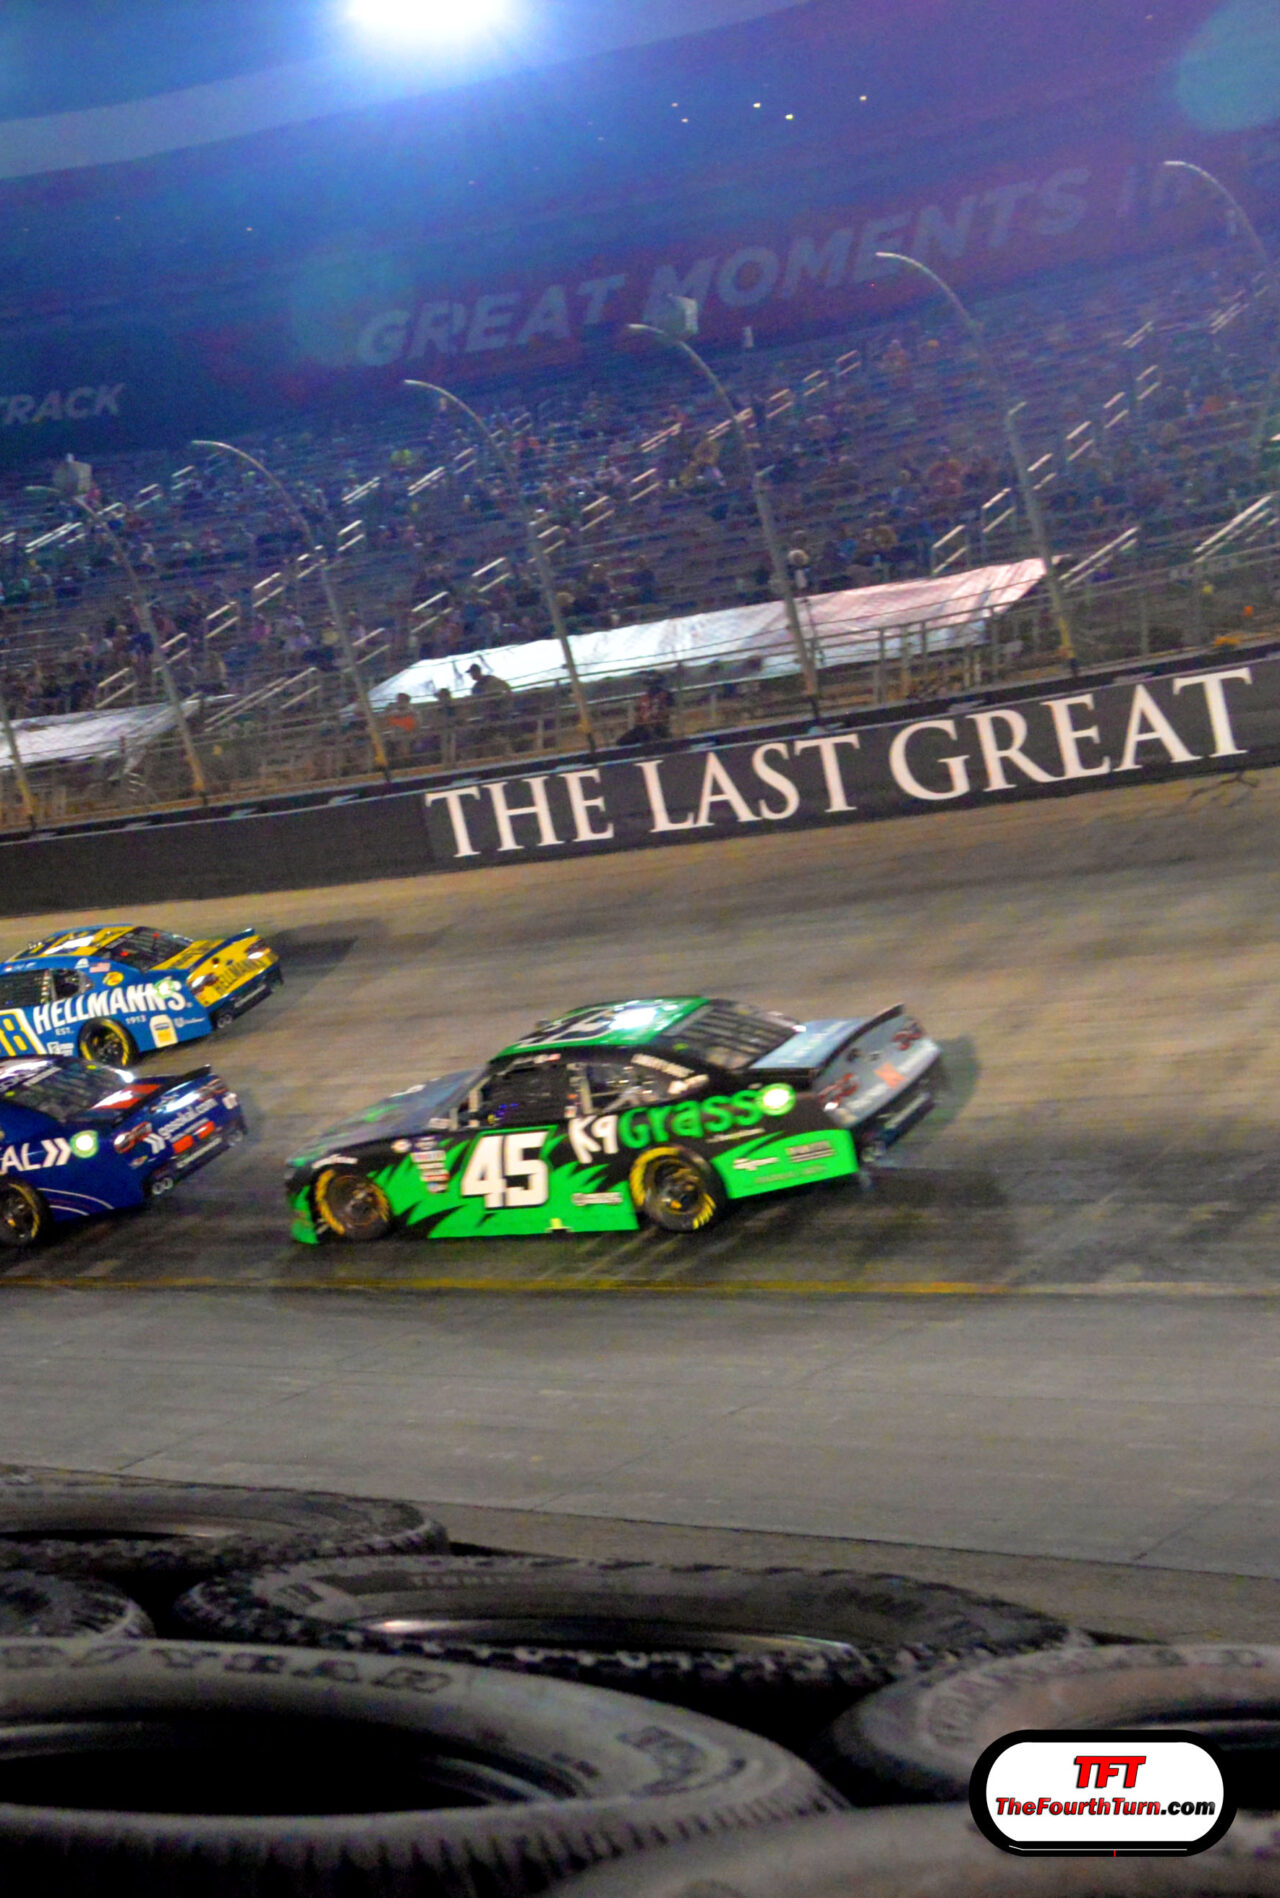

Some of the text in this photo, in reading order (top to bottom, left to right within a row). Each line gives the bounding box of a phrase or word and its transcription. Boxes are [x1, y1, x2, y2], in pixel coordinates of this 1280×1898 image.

[356, 273, 627, 366] GREAT
[642, 167, 1091, 326] MOMENTS
[425, 667, 1252, 857] THE LAST GREAT
[460, 1130, 550, 1209] 45
